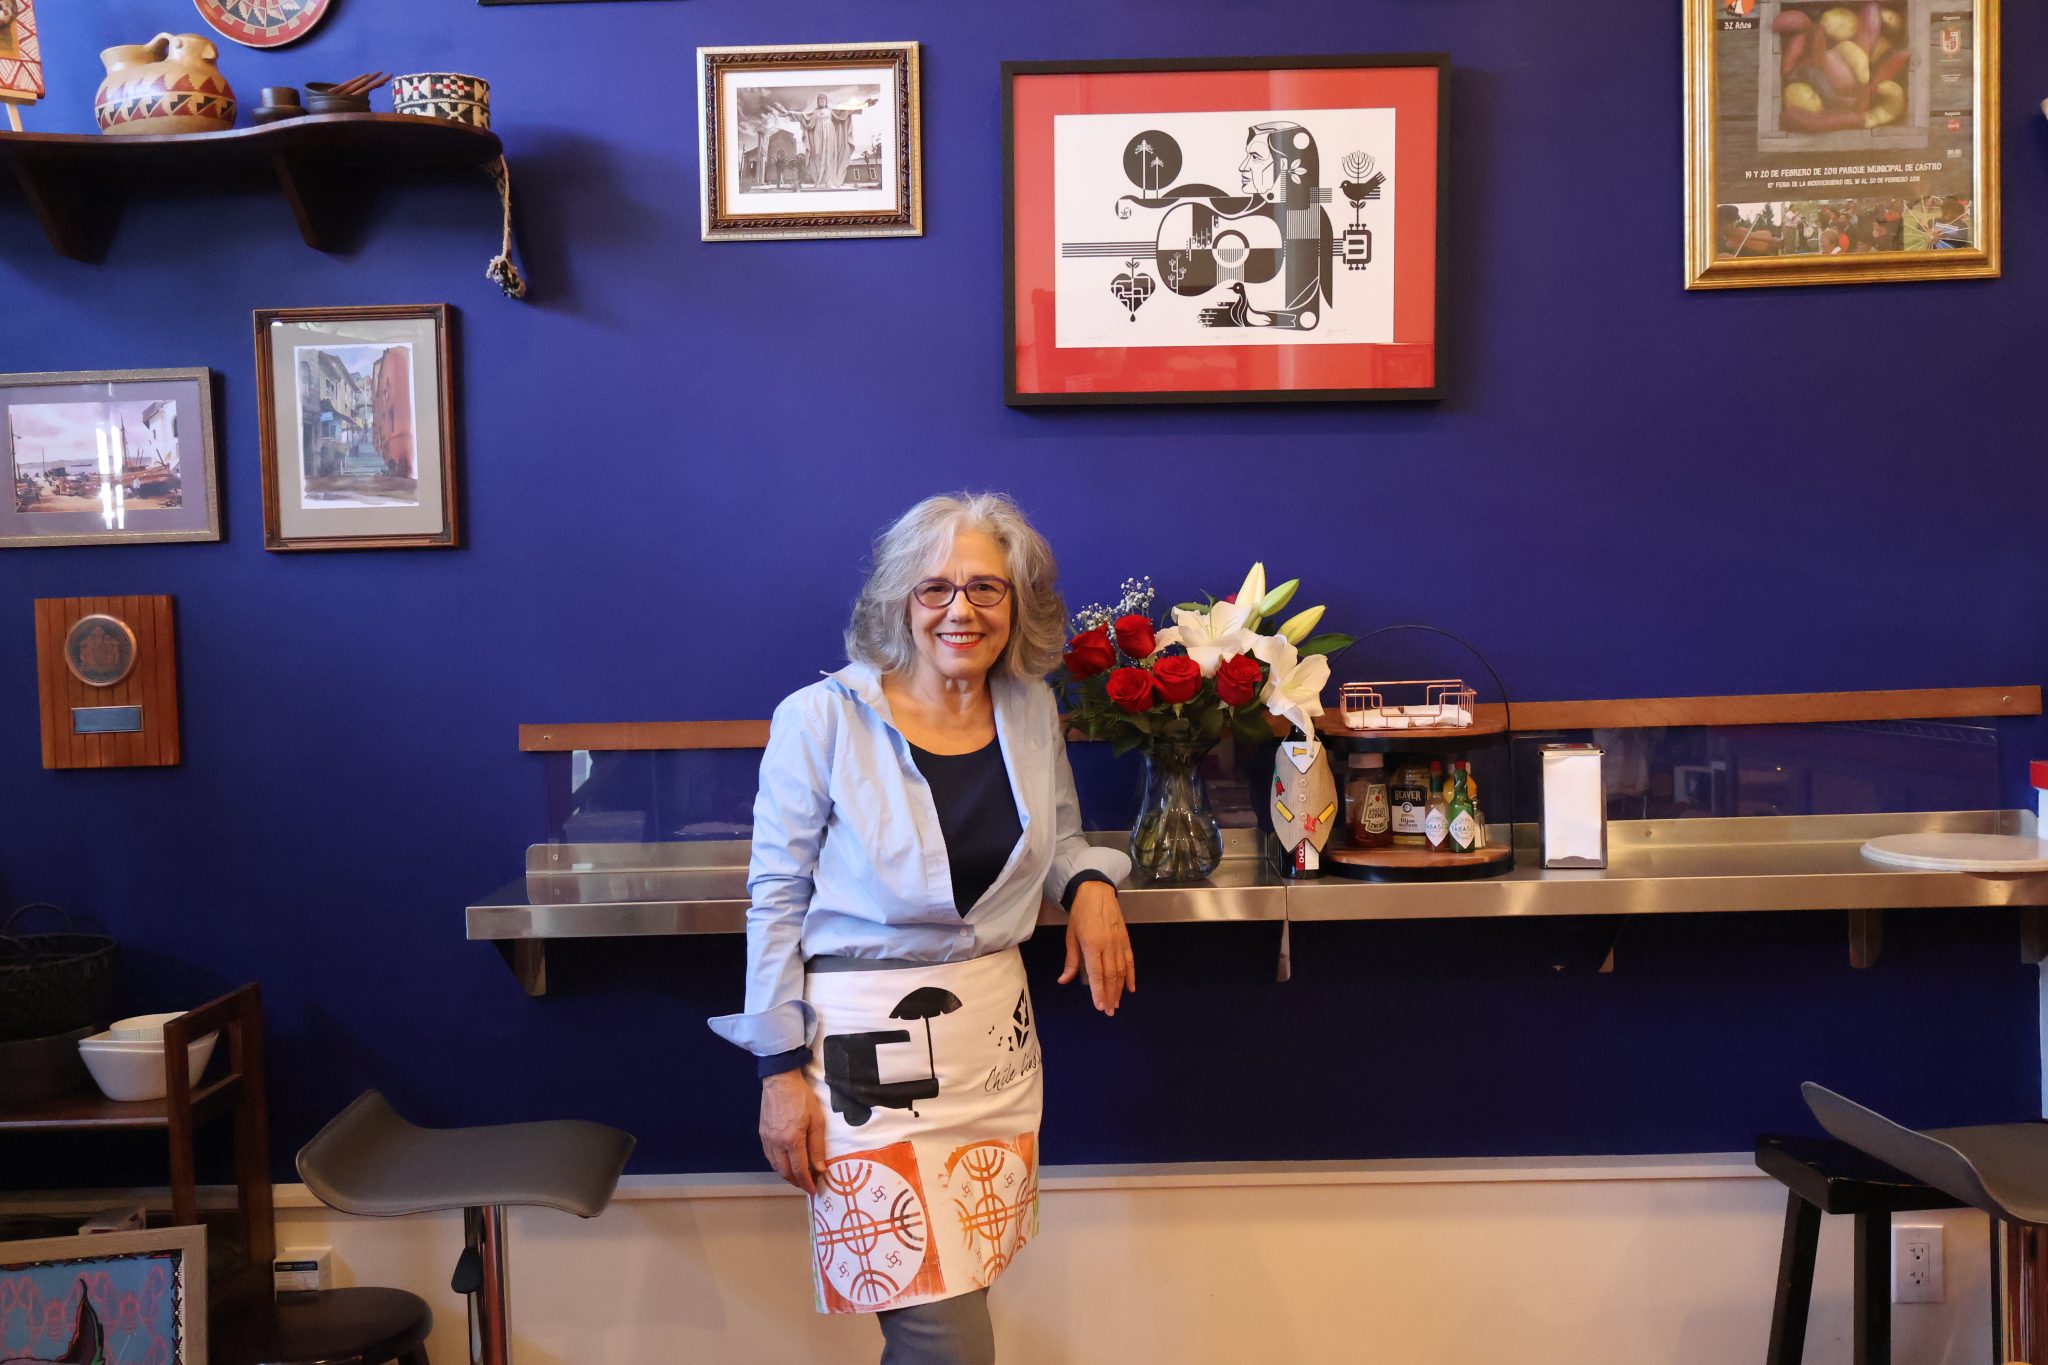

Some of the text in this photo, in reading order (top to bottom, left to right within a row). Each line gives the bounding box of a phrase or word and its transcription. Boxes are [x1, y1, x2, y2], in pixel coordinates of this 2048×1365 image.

[1724, 21, 1734, 30] 32
[1745, 162, 1943, 179] 19 Y 20 DE FEBRERO DE 2011 PARQUE MUNICIPAL DE CASTRO
[1394, 790, 1421, 801] BEAVER
